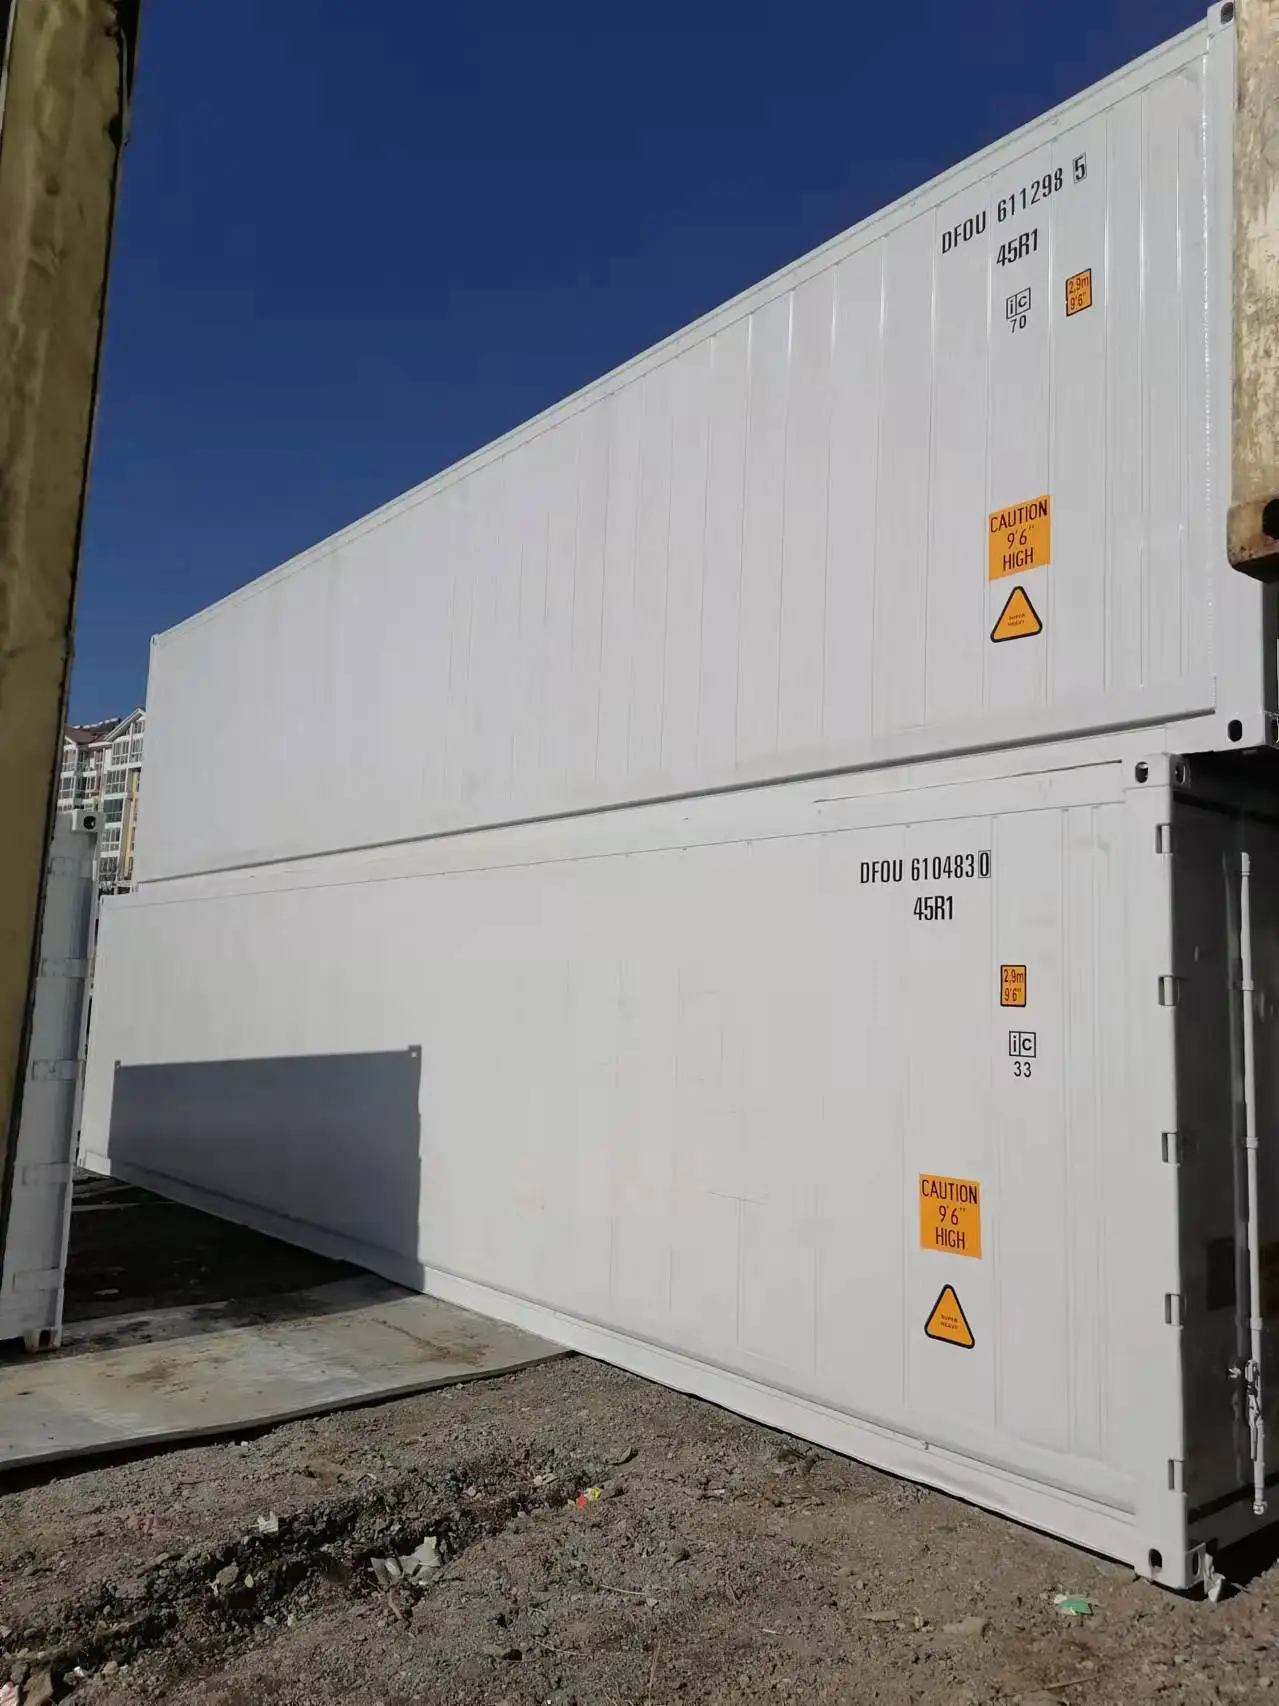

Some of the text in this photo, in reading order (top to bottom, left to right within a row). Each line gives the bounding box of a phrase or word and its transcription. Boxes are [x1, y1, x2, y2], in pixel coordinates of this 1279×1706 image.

[942, 154, 1086, 254] DFOU 611298 5
[996, 228, 1038, 267] 45R1
[1010, 314, 1027, 334] 70
[990, 499, 1048, 533] CAUTION
[1002, 546, 1034, 572] HIGH
[860, 859, 903, 884] DFOU
[913, 895, 953, 921] 45R1
[1013, 1060, 1032, 1078] 33
[921, 1179, 978, 1205] CAUTION
[935, 1227, 966, 1250] HIGH
